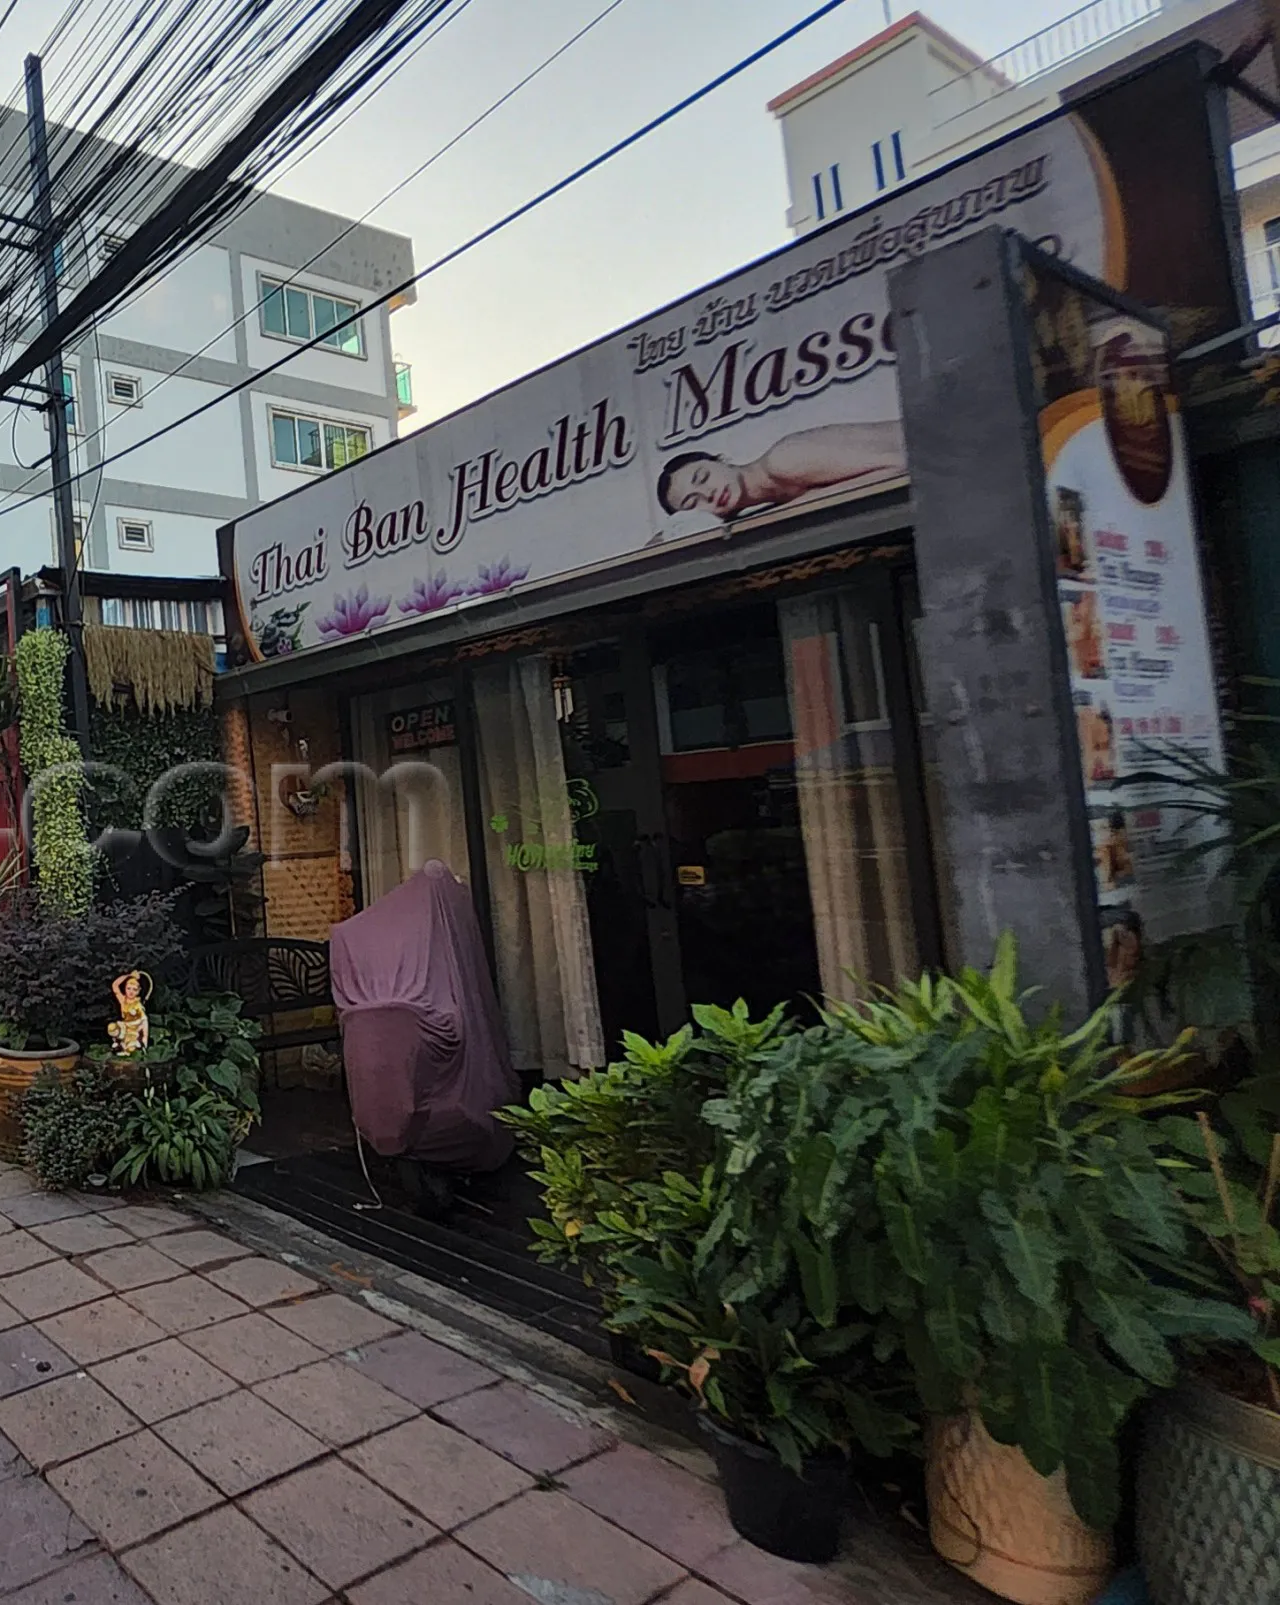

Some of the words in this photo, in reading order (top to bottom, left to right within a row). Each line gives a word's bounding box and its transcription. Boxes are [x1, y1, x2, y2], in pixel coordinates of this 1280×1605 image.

[629, 325, 687, 375] ไทย
[693, 292, 760, 345] บ้าน
[251, 527, 329, 599] Thai
[344, 498, 429, 557] Ban
[436, 396, 632, 551] Health
[391, 704, 450, 733] OPEN
[391, 723, 457, 751] WELCOME
